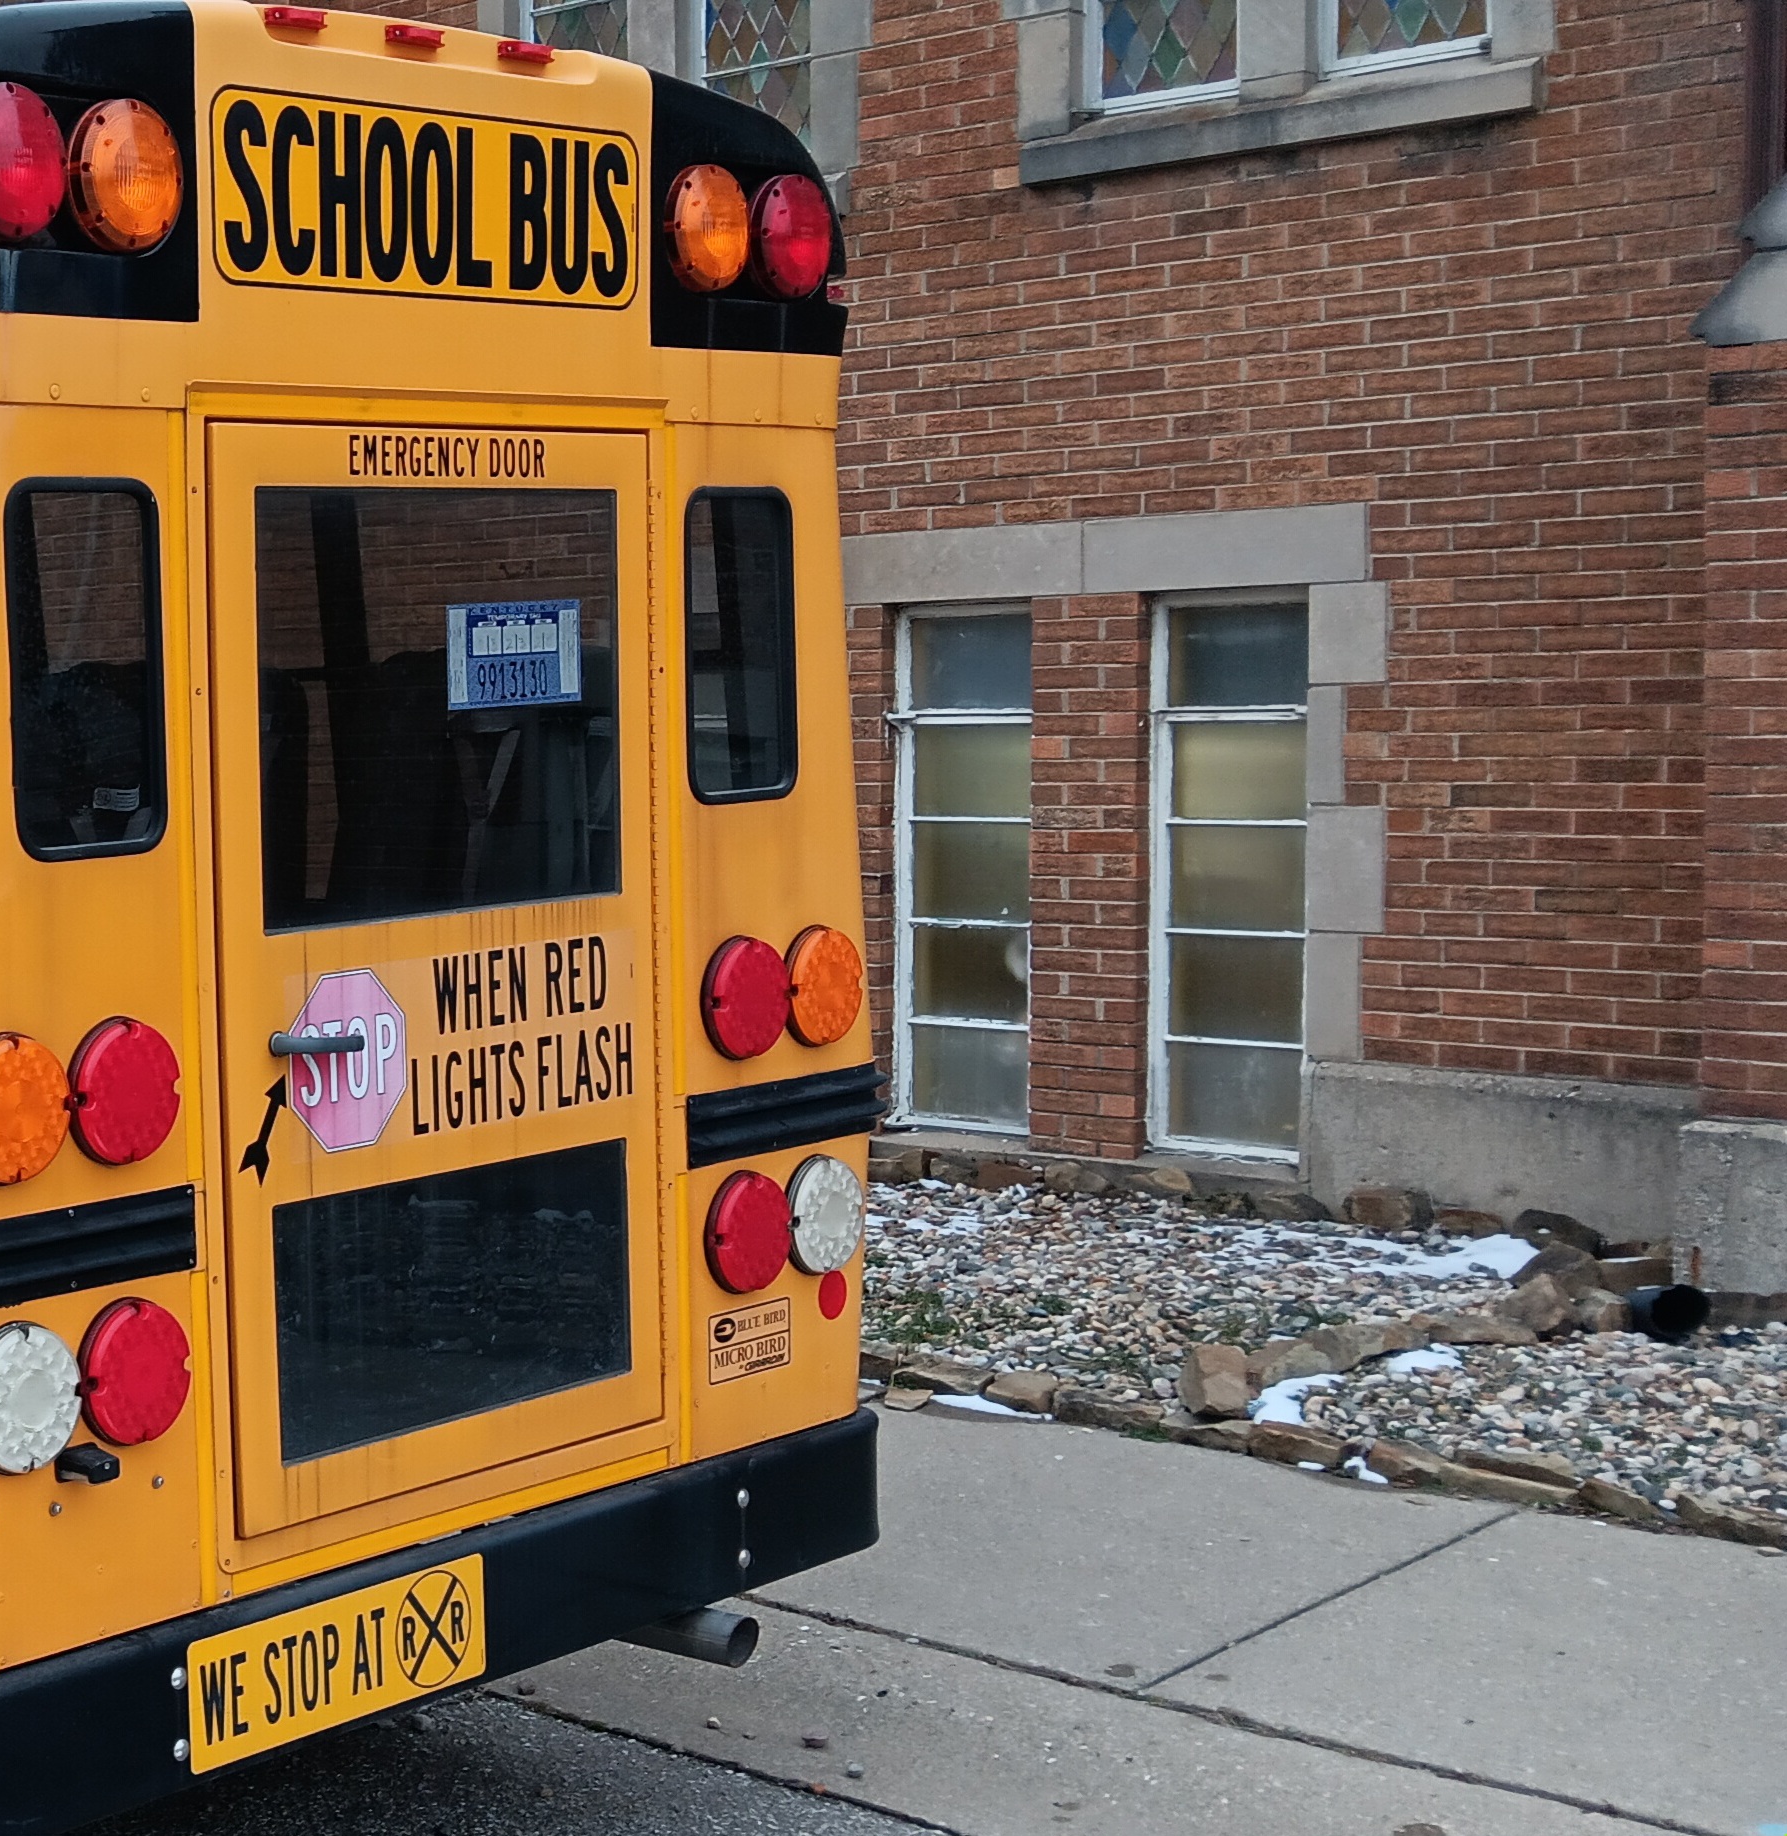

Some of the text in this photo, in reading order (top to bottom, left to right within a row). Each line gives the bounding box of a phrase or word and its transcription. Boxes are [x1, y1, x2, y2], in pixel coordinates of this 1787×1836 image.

[223, 99, 630, 298] SCHOOL BUS
[349, 434, 546, 478] EMERGENCY DOOR
[468, 604, 558, 614] KENTUCKY
[477, 659, 548, 700] 9913130
[432, 935, 607, 1035] WHEN RED
[299, 1012, 398, 1108] STOP
[411, 1022, 634, 1136] LIGHTS FLASH
[763, 1309, 785, 1325] BIRD
[714, 1336, 785, 1369] MICRO BIRD
[199, 1650, 249, 1746] WE
[263, 1623, 340, 1725] STOP
[352, 1606, 385, 1696] AT
